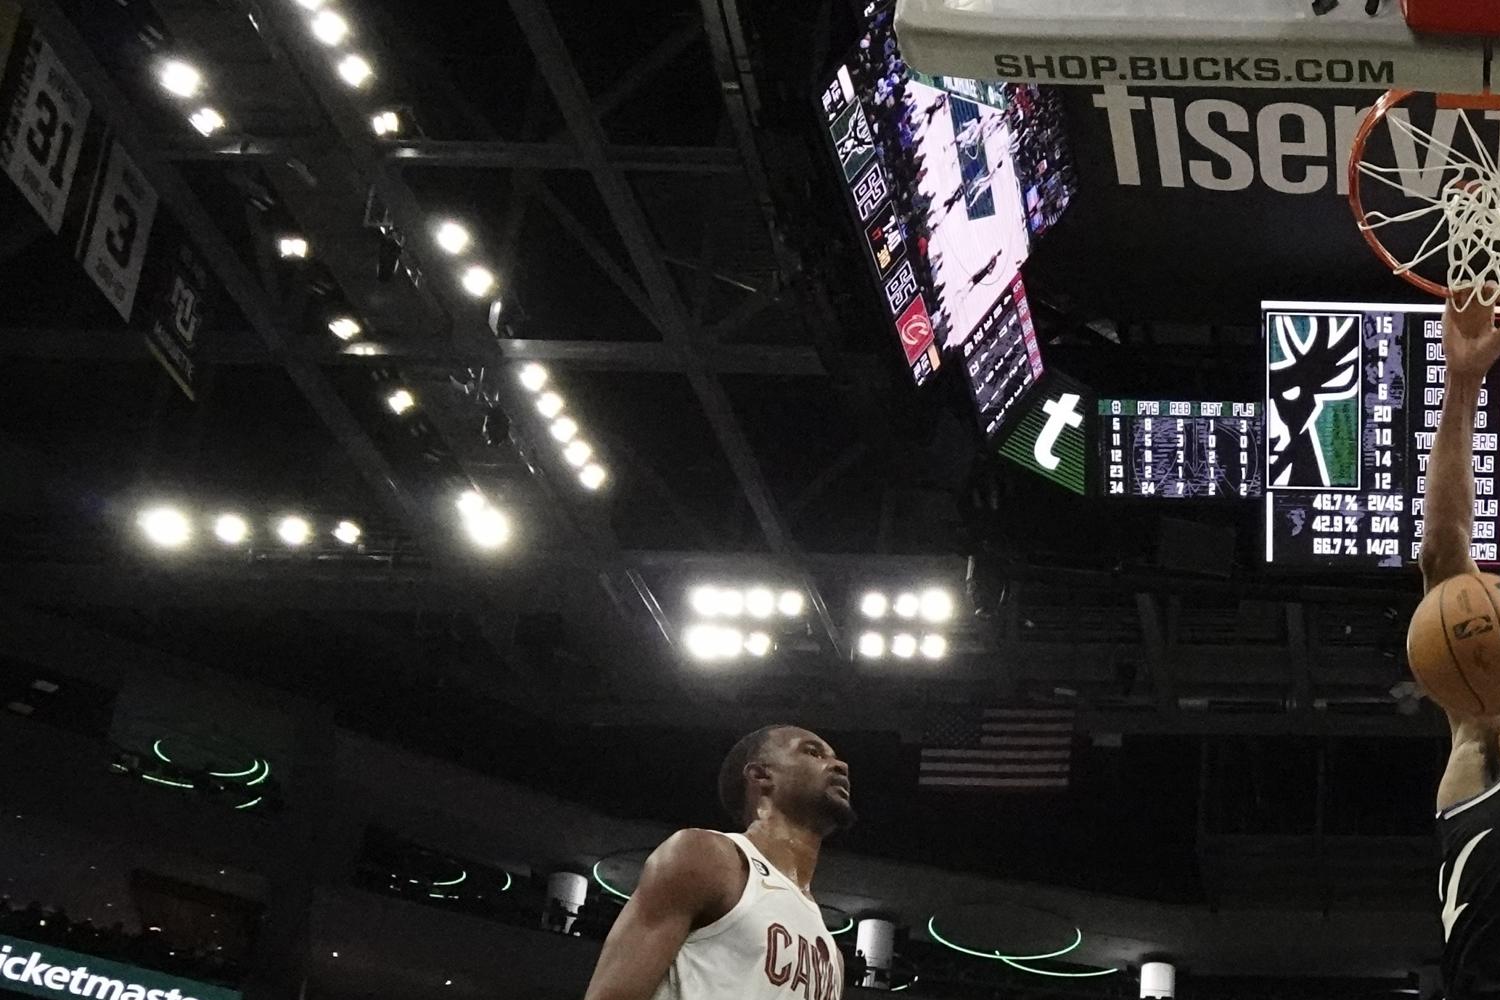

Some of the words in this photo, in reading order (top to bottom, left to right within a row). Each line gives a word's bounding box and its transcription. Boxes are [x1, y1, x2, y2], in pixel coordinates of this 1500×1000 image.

[993, 53, 1396, 85] SHOP.BUCKS.COM
[1092, 84, 1462, 199] fiserv
[1375, 315, 1393, 335] 15
[1378, 339, 1388, 357] 6
[1377, 361, 1384, 378] 1
[1378, 383, 1388, 401] 6
[1138, 401, 1159, 415] PTS
[1170, 402, 1191, 416] REB
[1201, 402, 1222, 416] AST
[1233, 403, 1254, 417] FLS
[1373, 405, 1392, 423] 20
[1112, 417, 1120, 431] 5
[1112, 433, 1120, 446] 11
[1375, 428, 1393, 446] 10
[1110, 449, 1122, 462] 12
[1375, 451, 1391, 466] 14
[1109, 465, 1123, 478] 23
[1109, 481, 1124, 494] 34
[1141, 481, 1155, 494] 24
[1375, 473, 1391, 489] 12
[1372, 517, 1398, 532] 6/14
[1367, 539, 1398, 555] 14/21
